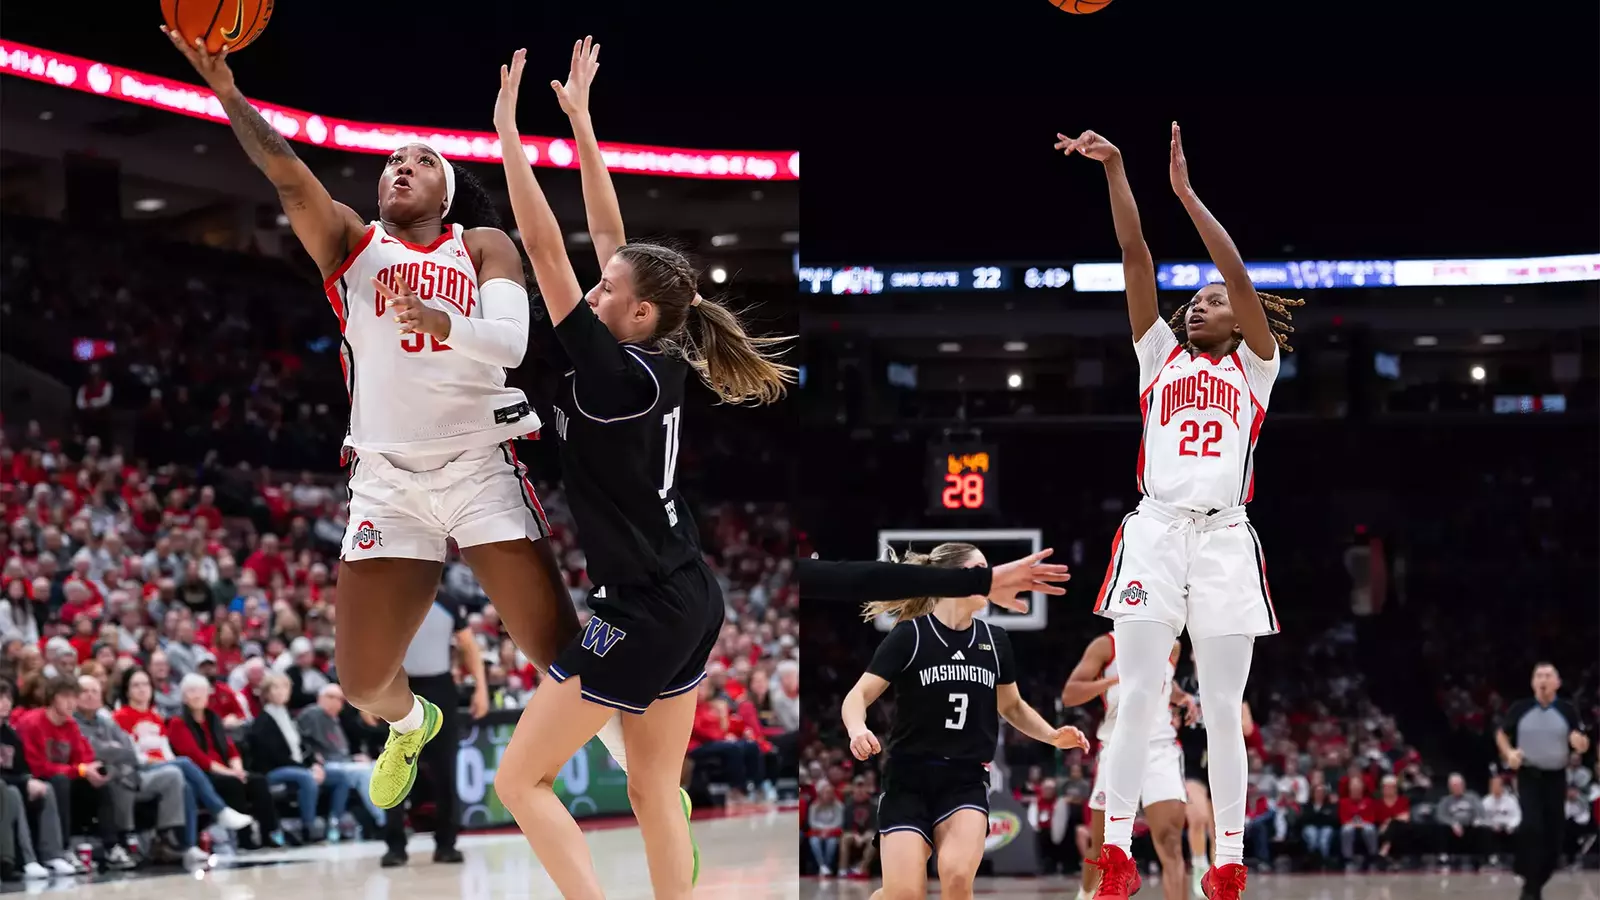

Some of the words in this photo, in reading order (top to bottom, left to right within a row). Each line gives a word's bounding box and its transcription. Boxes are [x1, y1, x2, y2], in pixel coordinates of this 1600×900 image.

[1179, 420, 1223, 457] 22
[942, 473, 984, 508] 28
[581, 615, 626, 657] W
[919, 664, 996, 689] WASHINGTON
[945, 693, 969, 730] 3
